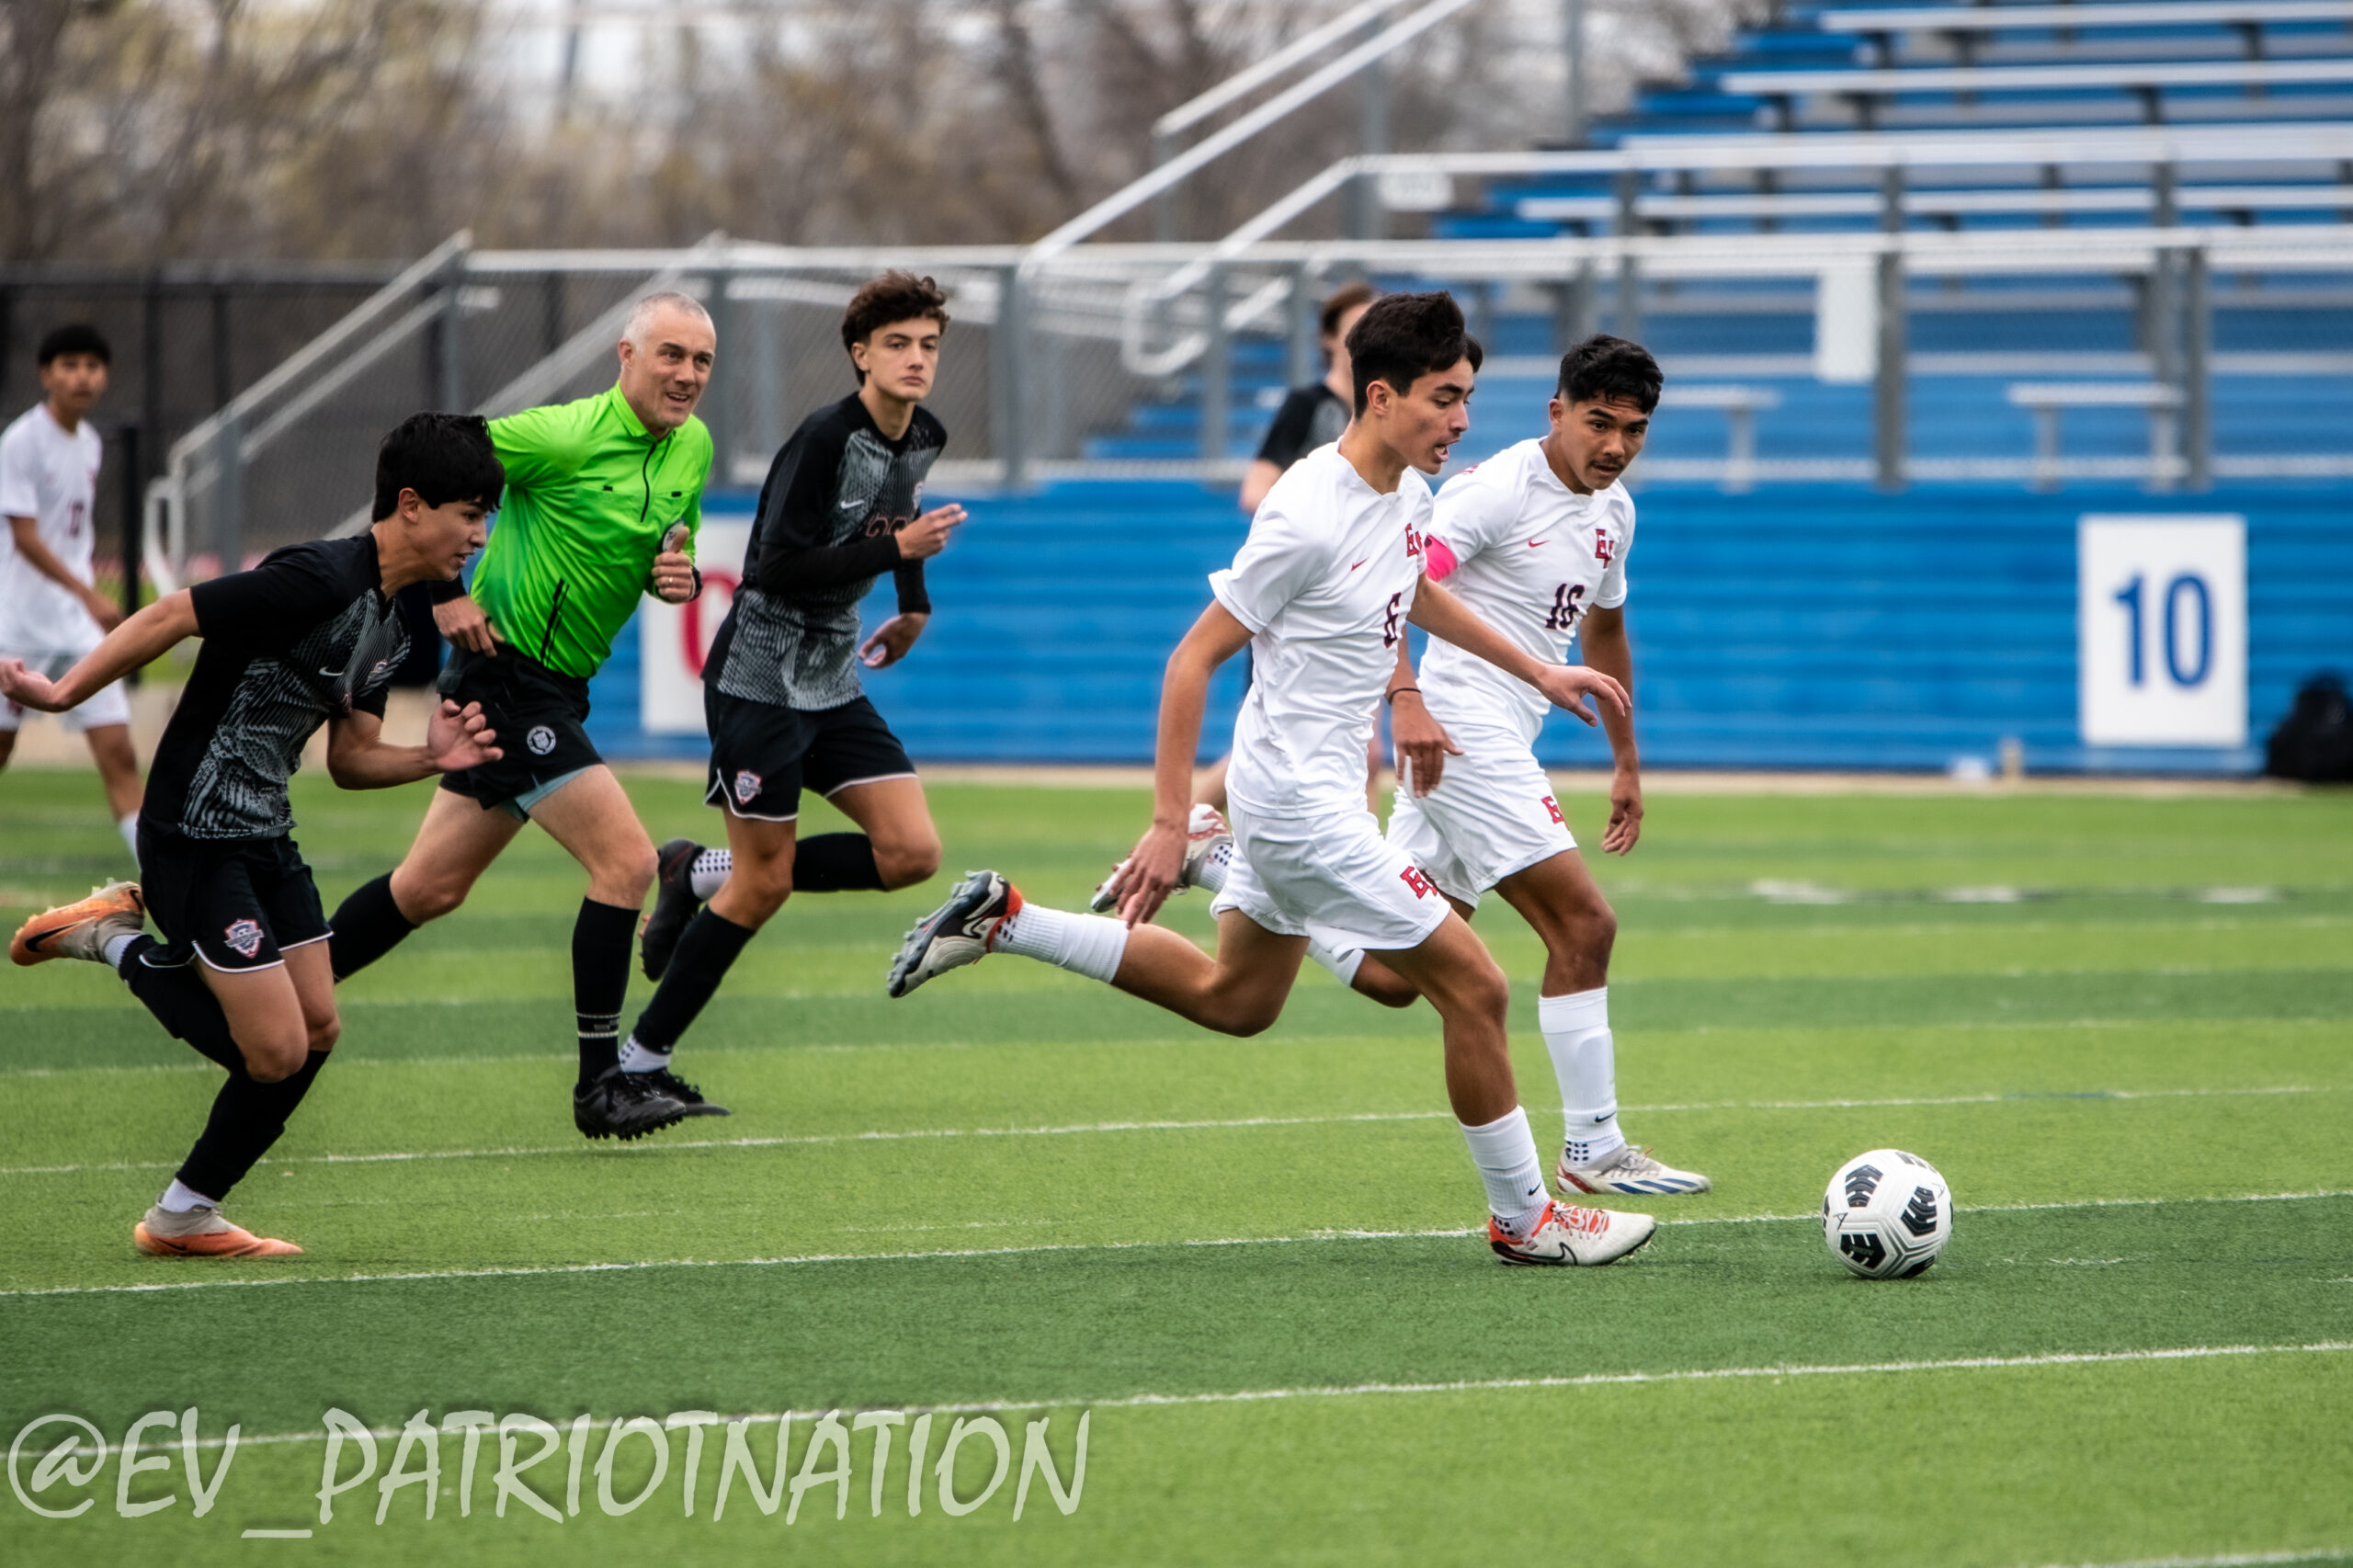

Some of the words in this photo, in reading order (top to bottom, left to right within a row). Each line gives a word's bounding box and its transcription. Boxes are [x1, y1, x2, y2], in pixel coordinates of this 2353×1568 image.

[1383, 592, 1402, 648] 6
[1545, 583, 1586, 630] 16
[2111, 571, 2216, 687] 10
